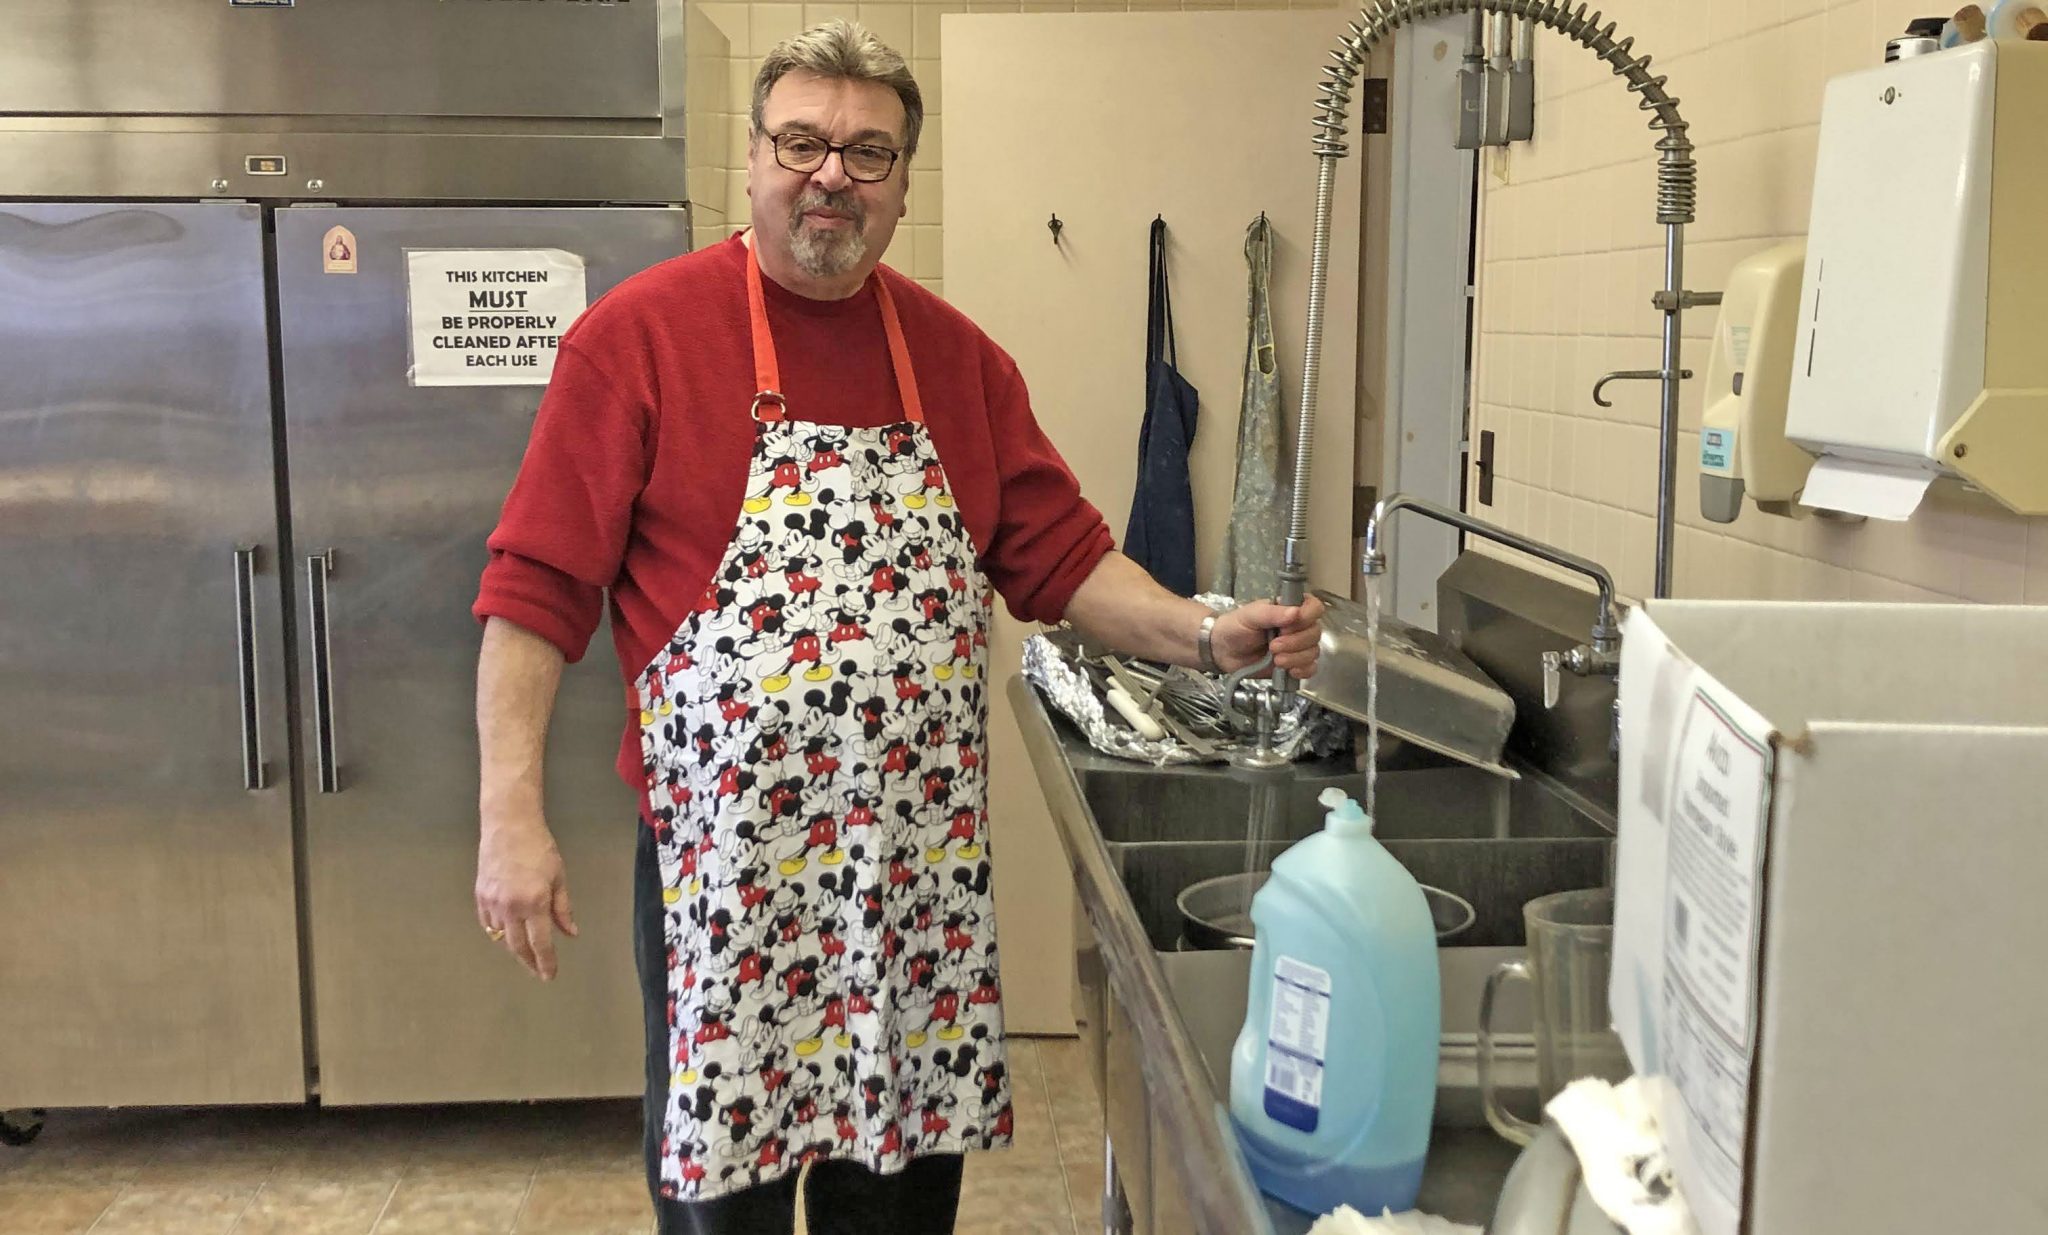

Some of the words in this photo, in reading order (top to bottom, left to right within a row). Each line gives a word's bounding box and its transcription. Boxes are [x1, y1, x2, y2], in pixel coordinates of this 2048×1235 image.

[446, 271, 478, 283] THIS
[482, 271, 548, 283] KITCHEN
[469, 290, 528, 308] MUST
[442, 316, 464, 329] BE
[468, 316, 557, 329] PROPERLY
[432, 335, 512, 349] CLEANED
[516, 335, 563, 348] AFTE
[466, 355, 507, 367] EACH
[511, 355, 538, 367] USE
